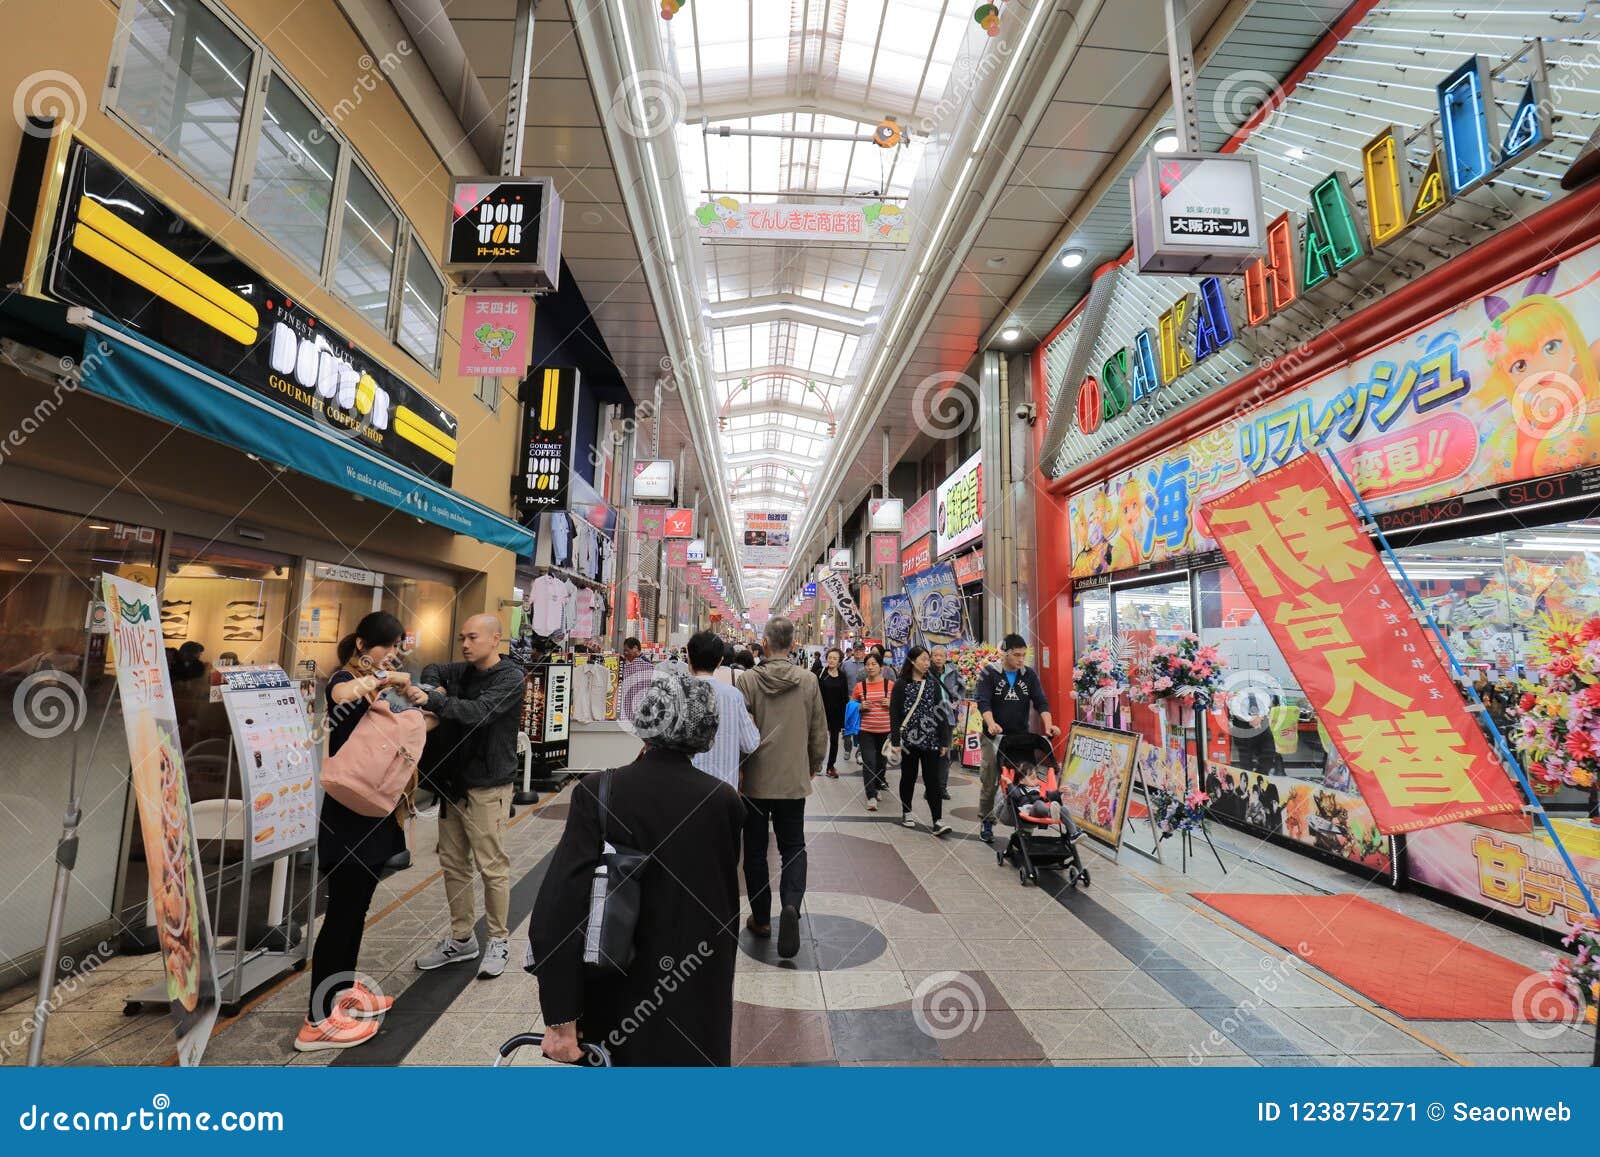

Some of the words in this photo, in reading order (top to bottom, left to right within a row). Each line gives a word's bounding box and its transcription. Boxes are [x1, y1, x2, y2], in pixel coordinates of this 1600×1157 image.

[747, 209, 864, 234] てんしきた商店街
[1173, 218, 1247, 234] 大阪ホール
[477, 247, 520, 257] ドトールコーヒー
[1078, 276, 1234, 436] OSAKA
[1244, 53, 1554, 328] HALL
[476, 301, 518, 315] 天四北
[277, 307, 314, 337] FINEST
[269, 375, 325, 412] GOURMET
[327, 406, 360, 433] COFFEE
[362, 422, 384, 445] SHOP
[1240, 344, 1471, 475] リフレッシュ
[529, 449, 561, 457] COFFEE
[346, 465, 357, 479] We
[356, 472, 372, 485] make
[525, 496, 559, 505] ドトールコーヒー
[1381, 501, 1463, 529] PACHINKO
[1508, 476, 1568, 505] SLOT
[967, 736, 979, 750] 5
